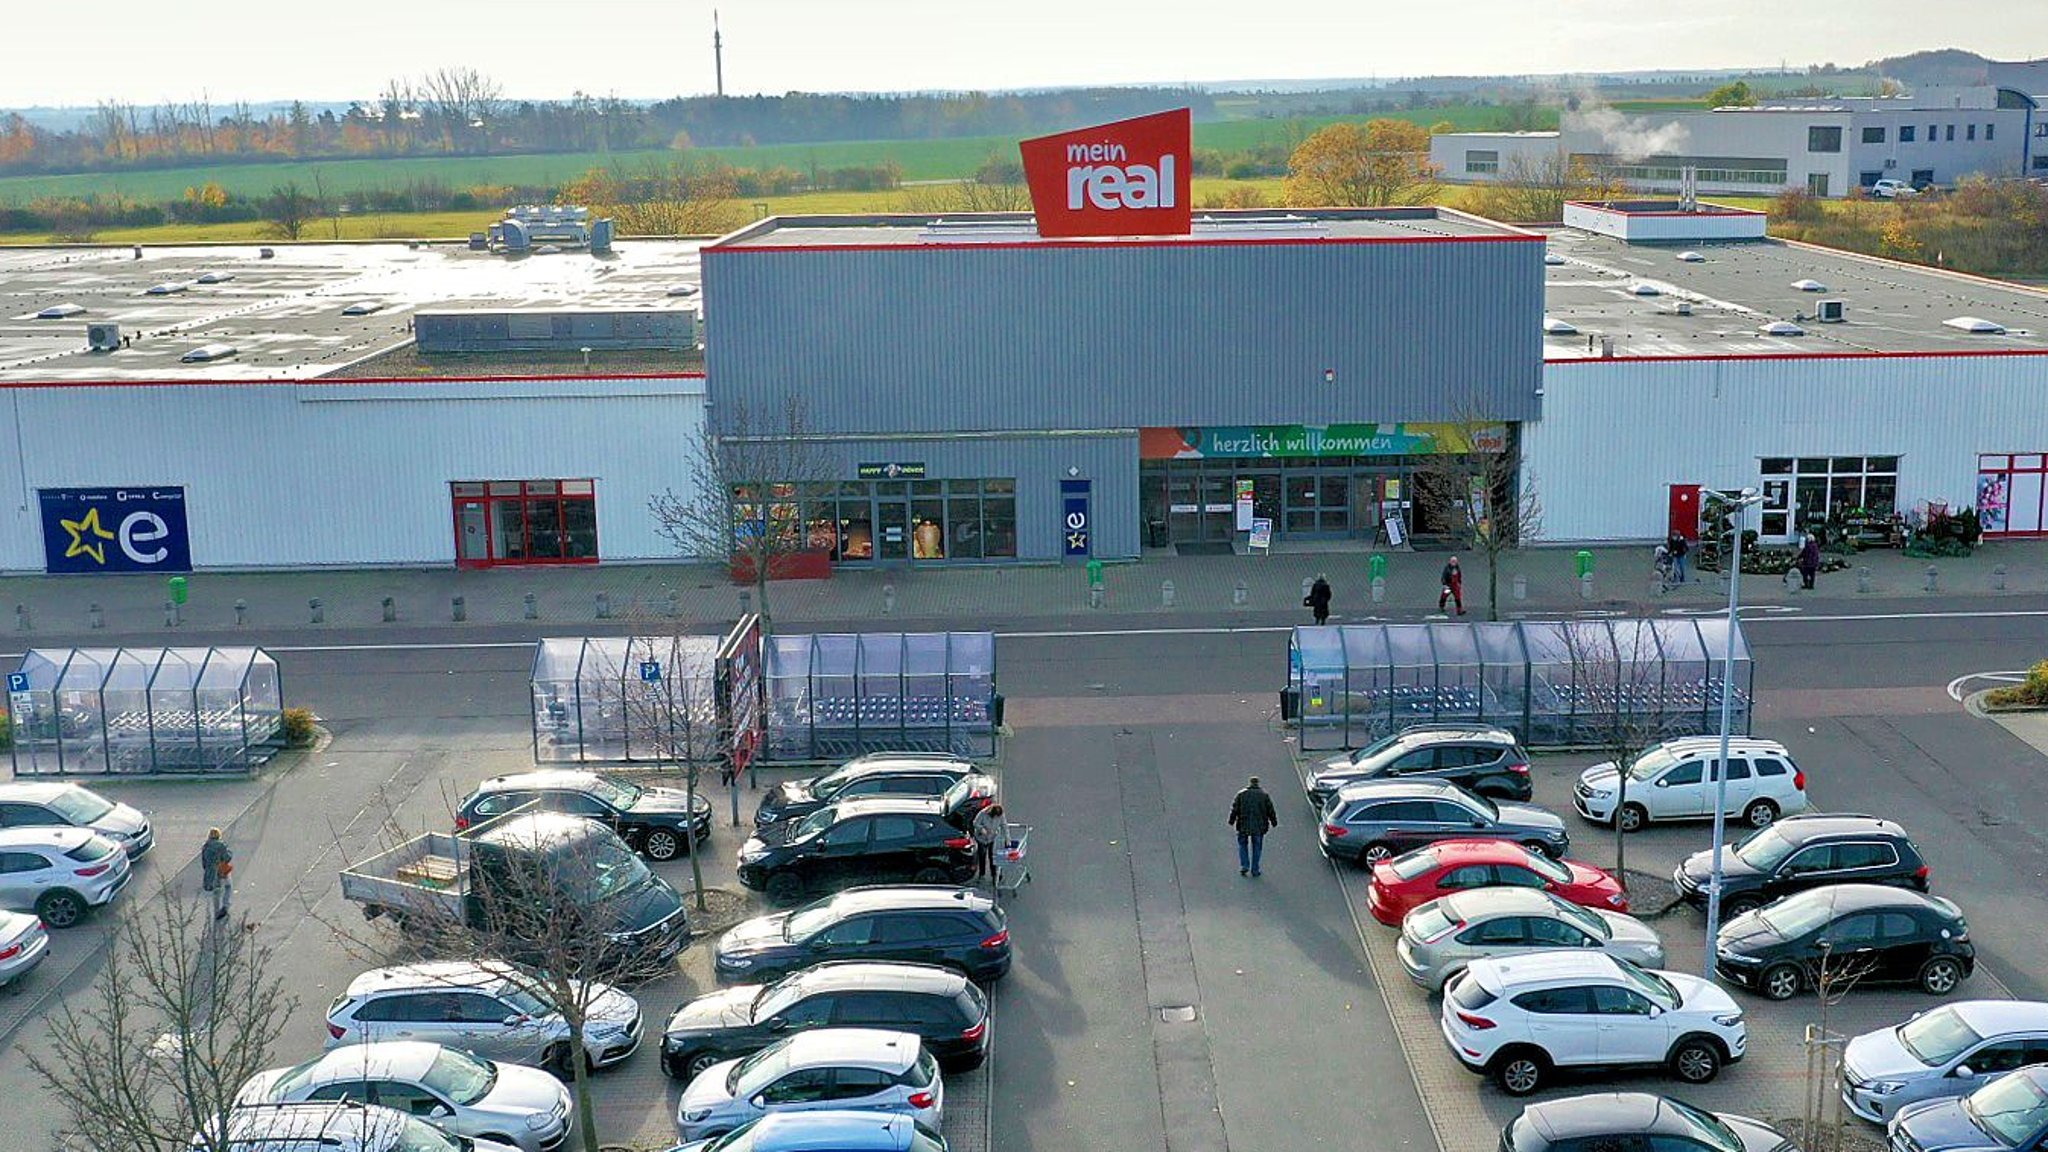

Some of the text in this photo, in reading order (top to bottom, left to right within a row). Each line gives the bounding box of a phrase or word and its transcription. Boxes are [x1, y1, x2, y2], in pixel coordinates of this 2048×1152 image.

[1067, 139, 1126, 162] mein
[1067, 154, 1175, 210] real
[1213, 432, 1393, 453] herzlich willkommen
[119, 511, 169, 564] e
[11, 675, 23, 690] P
